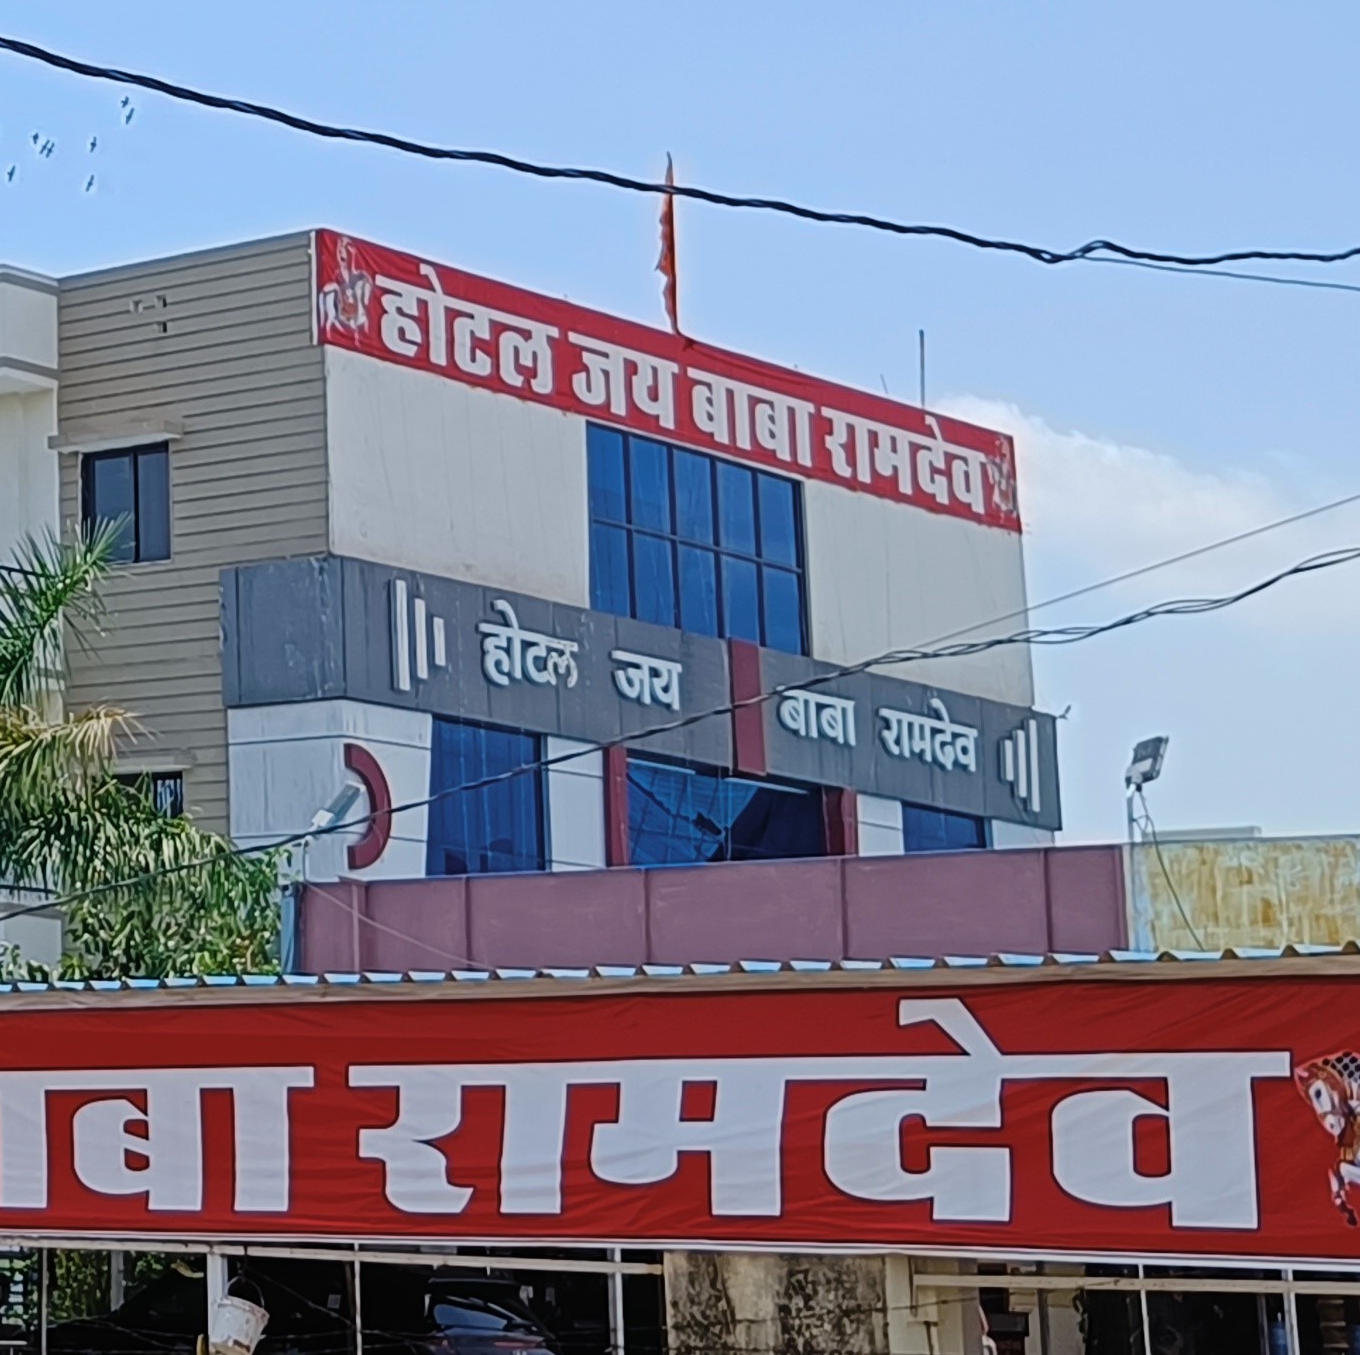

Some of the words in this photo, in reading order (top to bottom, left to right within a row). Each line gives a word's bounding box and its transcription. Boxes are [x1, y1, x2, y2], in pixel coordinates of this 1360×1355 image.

[375, 263, 559, 394] होटल
[568, 332, 679, 430] जय
[687, 367, 814, 467] बाबा
[820, 414, 987, 514] रामदेव
[477, 599, 579, 688] होटल
[610, 650, 682, 711] जय
[776, 685, 856, 747] बाबा
[878, 698, 978, 773] रामदेव
[347, 998, 1291, 1229] रामदेव
